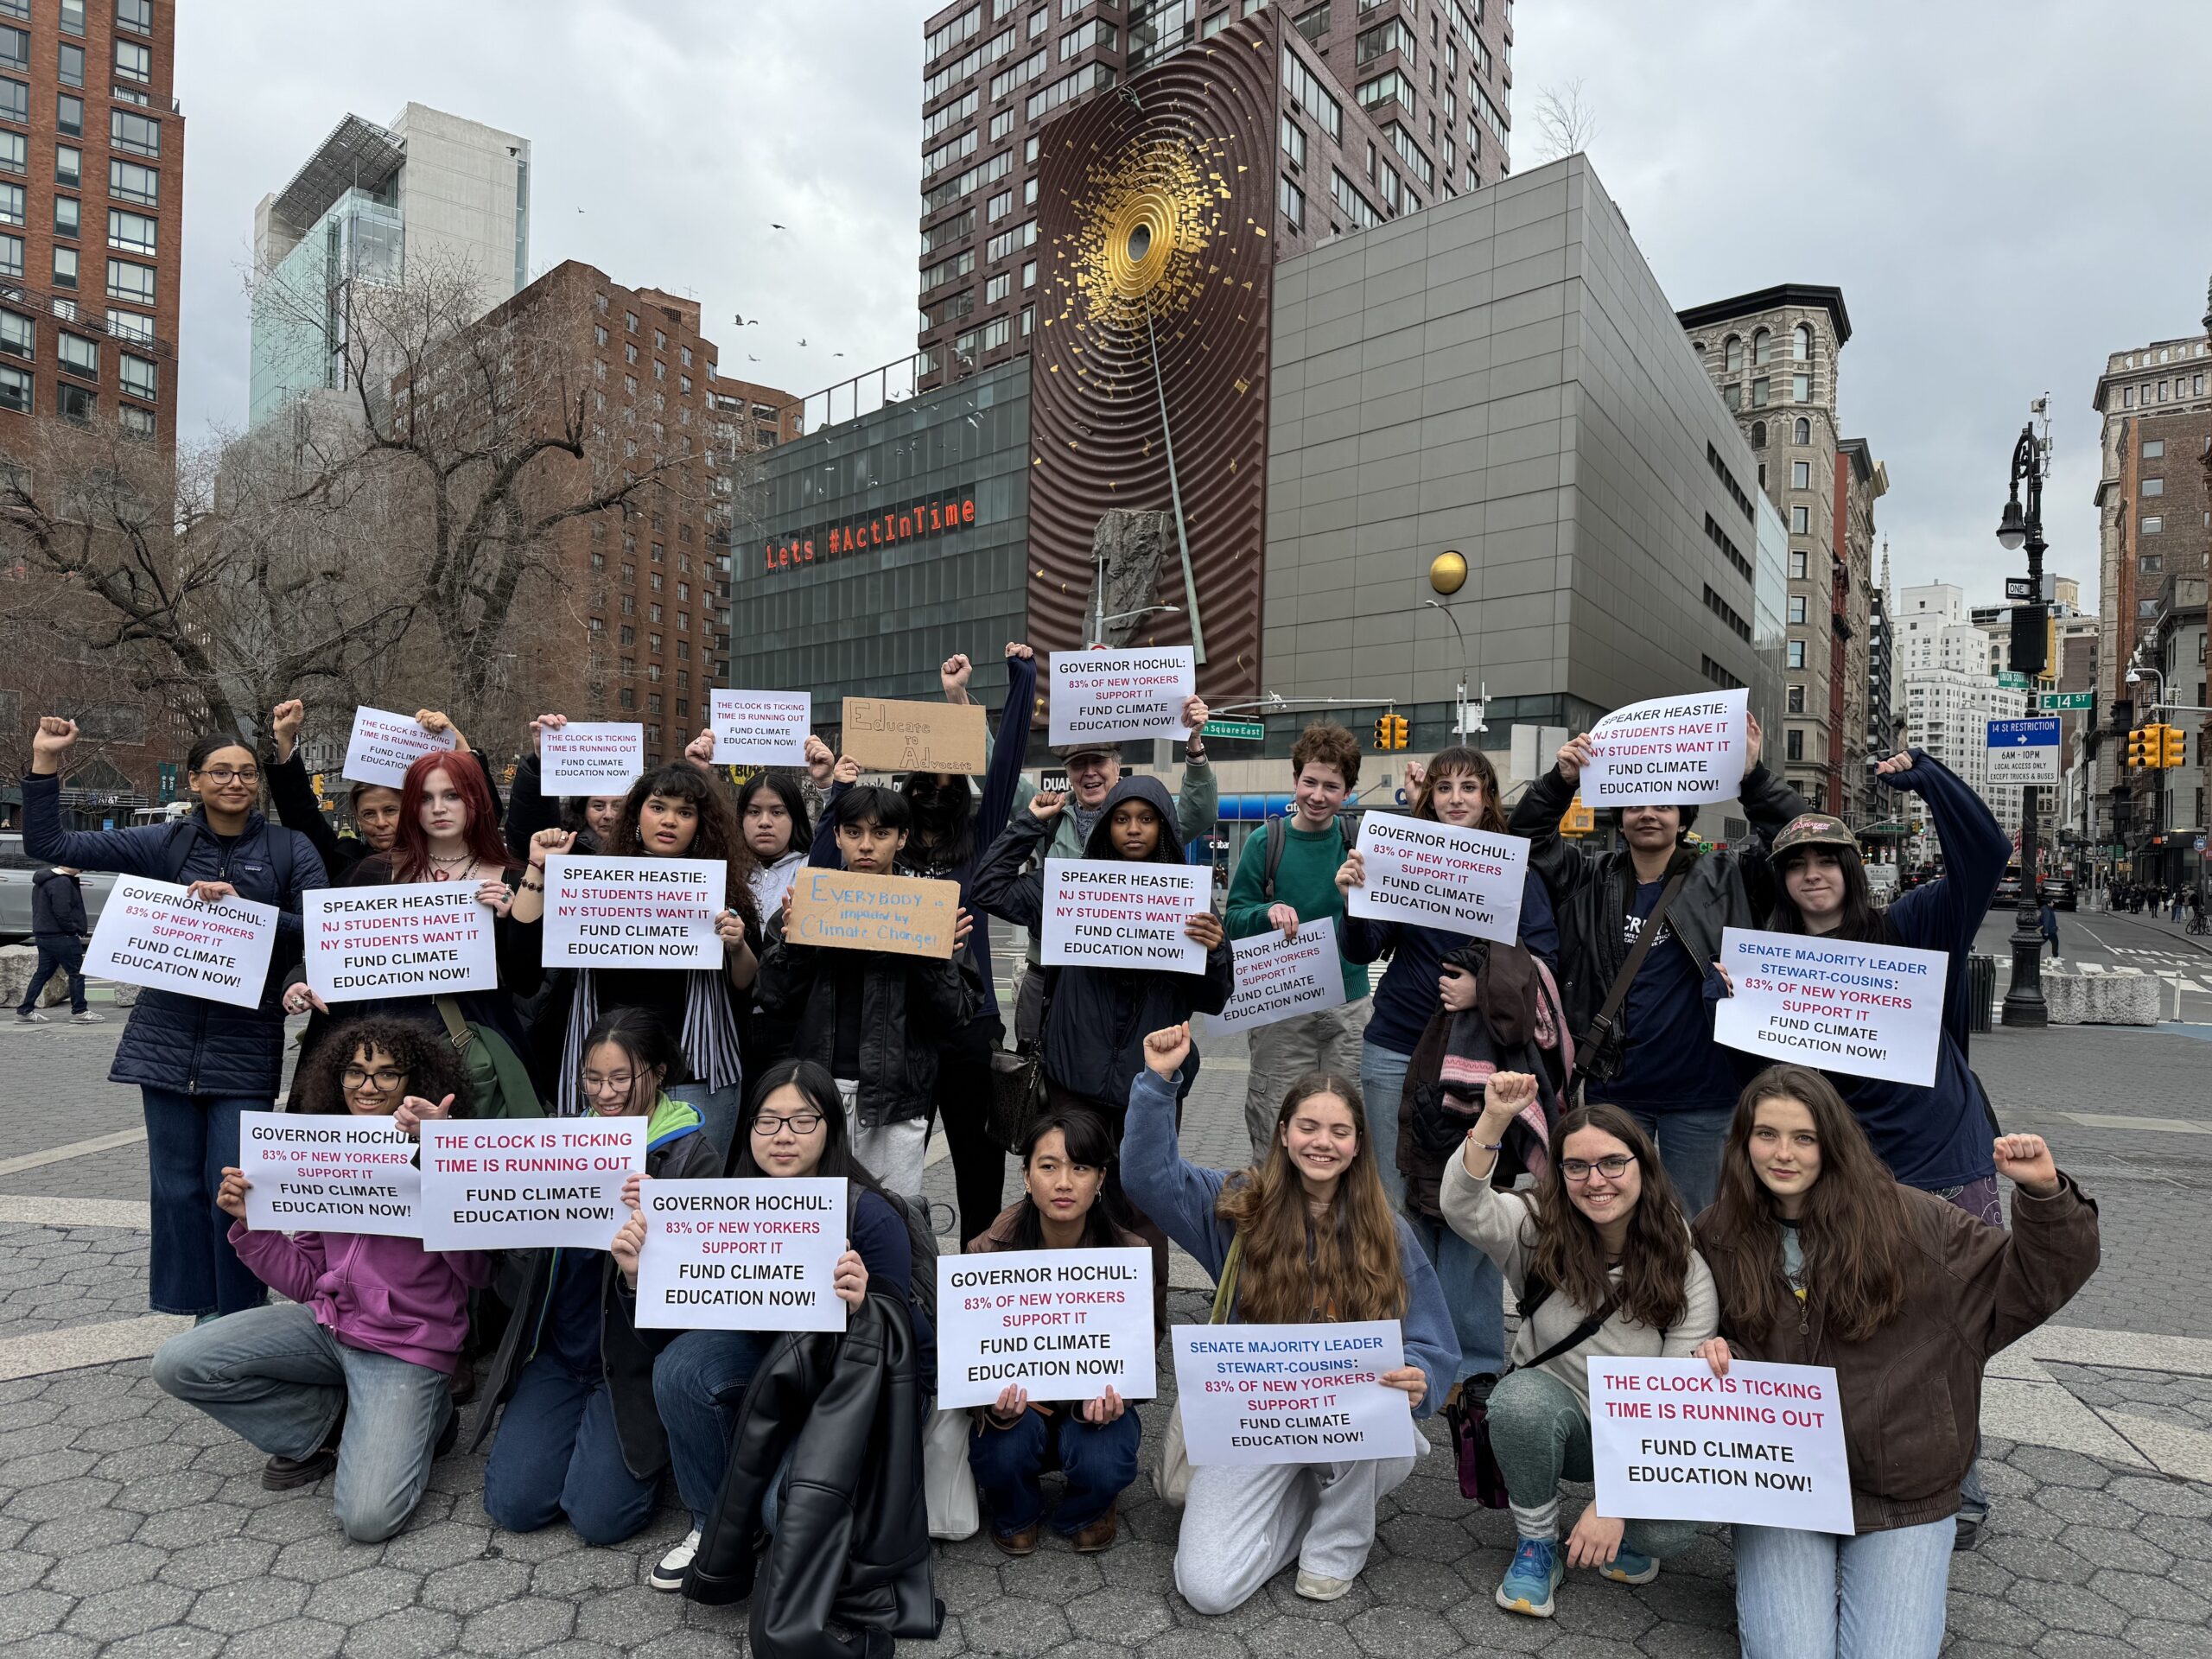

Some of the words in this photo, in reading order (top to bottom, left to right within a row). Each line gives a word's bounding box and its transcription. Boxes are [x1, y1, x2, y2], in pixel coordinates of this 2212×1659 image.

[766, 539, 814, 569] Lets
[829, 499, 976, 554] #ActInTime
[2010, 584, 2024, 594] ONE
[1059, 660, 1129, 673] GOVERNOR
[1133, 658, 1185, 670] HOCHUL:
[2000, 672, 2012, 682] UNION
[1096, 690, 1141, 699] SUPPORT
[2044, 695, 2051, 709] E
[2057, 695, 2071, 708] 14
[849, 701, 931, 733] Educate
[1070, 718, 1139, 730] EDUCATION
[1142, 715, 1174, 726] NOW!
[1602, 709, 1661, 727] SPEAKER
[1663, 702, 1727, 718] HEASTIE:
[361, 719, 378, 728] THE
[379, 722, 408, 734] CLOCK
[420, 731, 450, 745] TICKING
[1211, 725, 1239, 735] Square
[1241, 727, 1260, 735] East
[1992, 724, 1999, 733] 14
[2001, 723, 2009, 732] St
[2011, 721, 2055, 732] RESTRICTION
[369, 746, 394, 757] FUND
[395, 751, 420, 761] CLIMA
[1591, 747, 1605, 758] NY
[1608, 743, 1671, 756] STUDENTS
[1675, 741, 1713, 753] WANT
[1718, 741, 1730, 751] IT
[2001, 751, 2016, 760] 6AM
[2023, 750, 2040, 759] 10PM
[899, 747, 972, 770] Advocate
[2010, 772, 2030, 780] TRUCKS
[1043, 778, 1073, 791] DUAN
[1368, 823, 1445, 848] GOVERNOR
[1449, 838, 1515, 861] HOCHUL:
[1373, 843, 1394, 855] 83%
[1398, 849, 1413, 858] OF
[1416, 852, 1442, 864] NEW
[1446, 857, 1501, 875] YORKERS
[563, 868, 633, 881] SPEAKER
[639, 870, 706, 883] HEASTIE:
[811, 874, 923, 906] EVERYBODY
[1059, 890, 1074, 899] NJ
[1078, 890, 1143, 903] STUDENTS
[1147, 894, 1179, 906] HAVE
[1184, 897, 1194, 906] IT
[123, 887, 204, 912] GOVERNOR
[207, 903, 265, 926] HOCHUL:
[323, 898, 397, 913] SPEAKER
[403, 893, 472, 908] HEASTIE:
[558, 906, 576, 916] NY
[581, 906, 652, 917] STUDENTS
[656, 908, 694, 918] WANT
[698, 909, 709, 918] IT
[895, 911, 908, 924] by
[125, 906, 148, 917] 83%
[151, 911, 168, 920] OF
[170, 914, 199, 927] NEW
[202, 920, 254, 939] YORKERS
[322, 921, 339, 931] NJ
[344, 916, 418, 931] STUDENTS
[423, 913, 460, 925] HAVE
[464, 912, 475, 922] IT
[801, 913, 869, 939] Climate
[1075, 925, 1112, 937] FUND
[1116, 927, 1174, 940] CLIMATE
[1738, 943, 1791, 958] SENATE
[1795, 950, 1866, 967] MAJORITY
[1869, 958, 1927, 975] LEADER
[1242, 968, 1286, 987] SUPPORT
[1288, 965, 1297, 974] IT
[1761, 963, 1898, 989] STEWART-COUSINS:
[1230, 988, 1262, 1005] FUND
[1265, 975, 1315, 995] CLIMATE
[1224, 996, 1292, 1021] EDUCATION
[1294, 987, 1325, 1003] NOW!
[1782, 1000, 1853, 1019] SUPPORT
[1856, 1009, 1869, 1020] IT
[262, 1149, 286, 1160] 83%
[290, 1151, 307, 1160] OF
[312, 1152, 340, 1162] NEW
[344, 1153, 407, 1164] YORKERS
[434, 1159, 477, 1172] TIME
[483, 1159, 499, 1172] IS
[505, 1157, 588, 1172] RUNNING
[594, 1156, 631, 1170] OUT
[467, 1188, 516, 1201] FUND
[522, 1186, 601, 1200] CLIMATE
[271, 1201, 364, 1214] EDUCATION
[368, 1204, 410, 1217] NOW!
[652, 1196, 750, 1211] GOVERNOR
[755, 1195, 832, 1210] HOCHUL:
[702, 1242, 766, 1254] SUPPORT
[771, 1242, 783, 1254] IT
[679, 1264, 725, 1279] FUND
[730, 1264, 804, 1280] CLIMATE
[964, 1296, 991, 1310] 83%
[995, 1294, 1014, 1307] OF
[1020, 1293, 1052, 1306] NEW
[1055, 1291, 1124, 1304] YORKERS
[1190, 1341, 1244, 1353] SENATE
[1248, 1340, 1319, 1352] MAJORITY
[1324, 1337, 1382, 1351] LEADER
[968, 1360, 1070, 1382] EDUCATION
[1076, 1359, 1123, 1375] NOW!
[1217, 1358, 1358, 1373] STEWART-COUSINS:
[1603, 1375, 1640, 1390] THE
[1646, 1376, 1713, 1392] CLOCK
[1719, 1376, 1738, 1394] IS
[1742, 1379, 1821, 1400] TICKING
[1231, 1434, 1318, 1446] EDUCATION
[1322, 1431, 1363, 1444] NOW!
[1628, 1465, 1747, 1486] EDUCATION
[1754, 1471, 1812, 1492] NOW!
